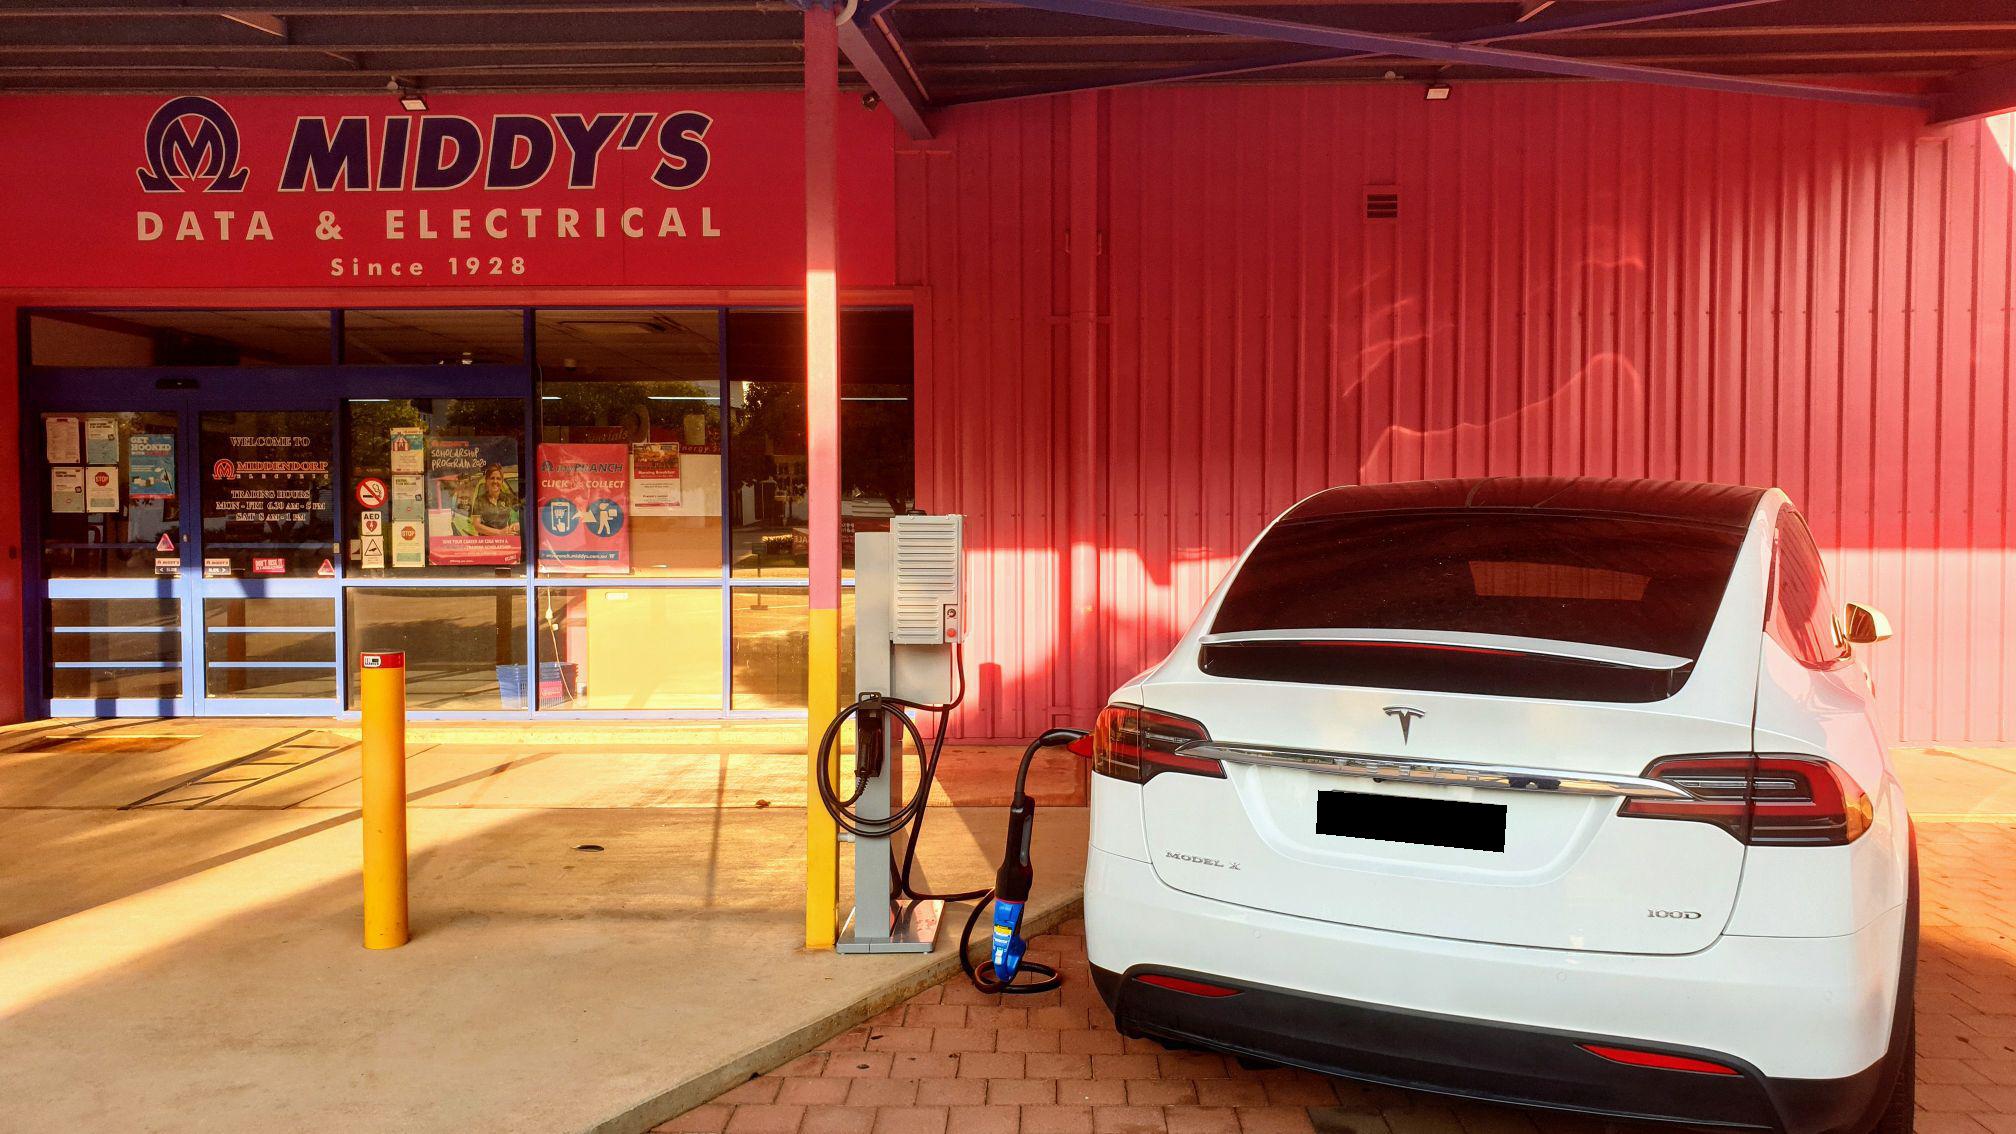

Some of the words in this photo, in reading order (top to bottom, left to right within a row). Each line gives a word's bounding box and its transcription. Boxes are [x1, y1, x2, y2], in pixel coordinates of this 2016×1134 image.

[278, 110, 714, 192] MIDDY'S
[137, 210, 274, 241] DATA
[317, 211, 343, 241] &
[386, 207, 721, 239] ELECTRICAL
[331, 257, 424, 276] Since
[448, 257, 527, 276] 1928
[230, 437, 291, 447] WELCOME
[293, 437, 310, 447] TO
[431, 448, 479, 457] SCHOLARSHIP
[237, 462, 329, 471] MIDDENDORF
[431, 459, 471, 470] PROGRAM
[541, 480, 568, 488] CLICK
[585, 480, 625, 488] COLLECT
[231, 490, 275, 499] TRADING
[277, 490, 310, 499] HOURS
[216, 501, 240, 510] MON
[247, 501, 264, 510] FRI
[286, 502, 300, 510] AM
[312, 502, 325, 510] PM
[236, 513, 255, 521] SAT
[1165, 851, 1225, 868] MODEL
[1228, 862, 1241, 871] X
[1647, 909, 1702, 920] 100D
